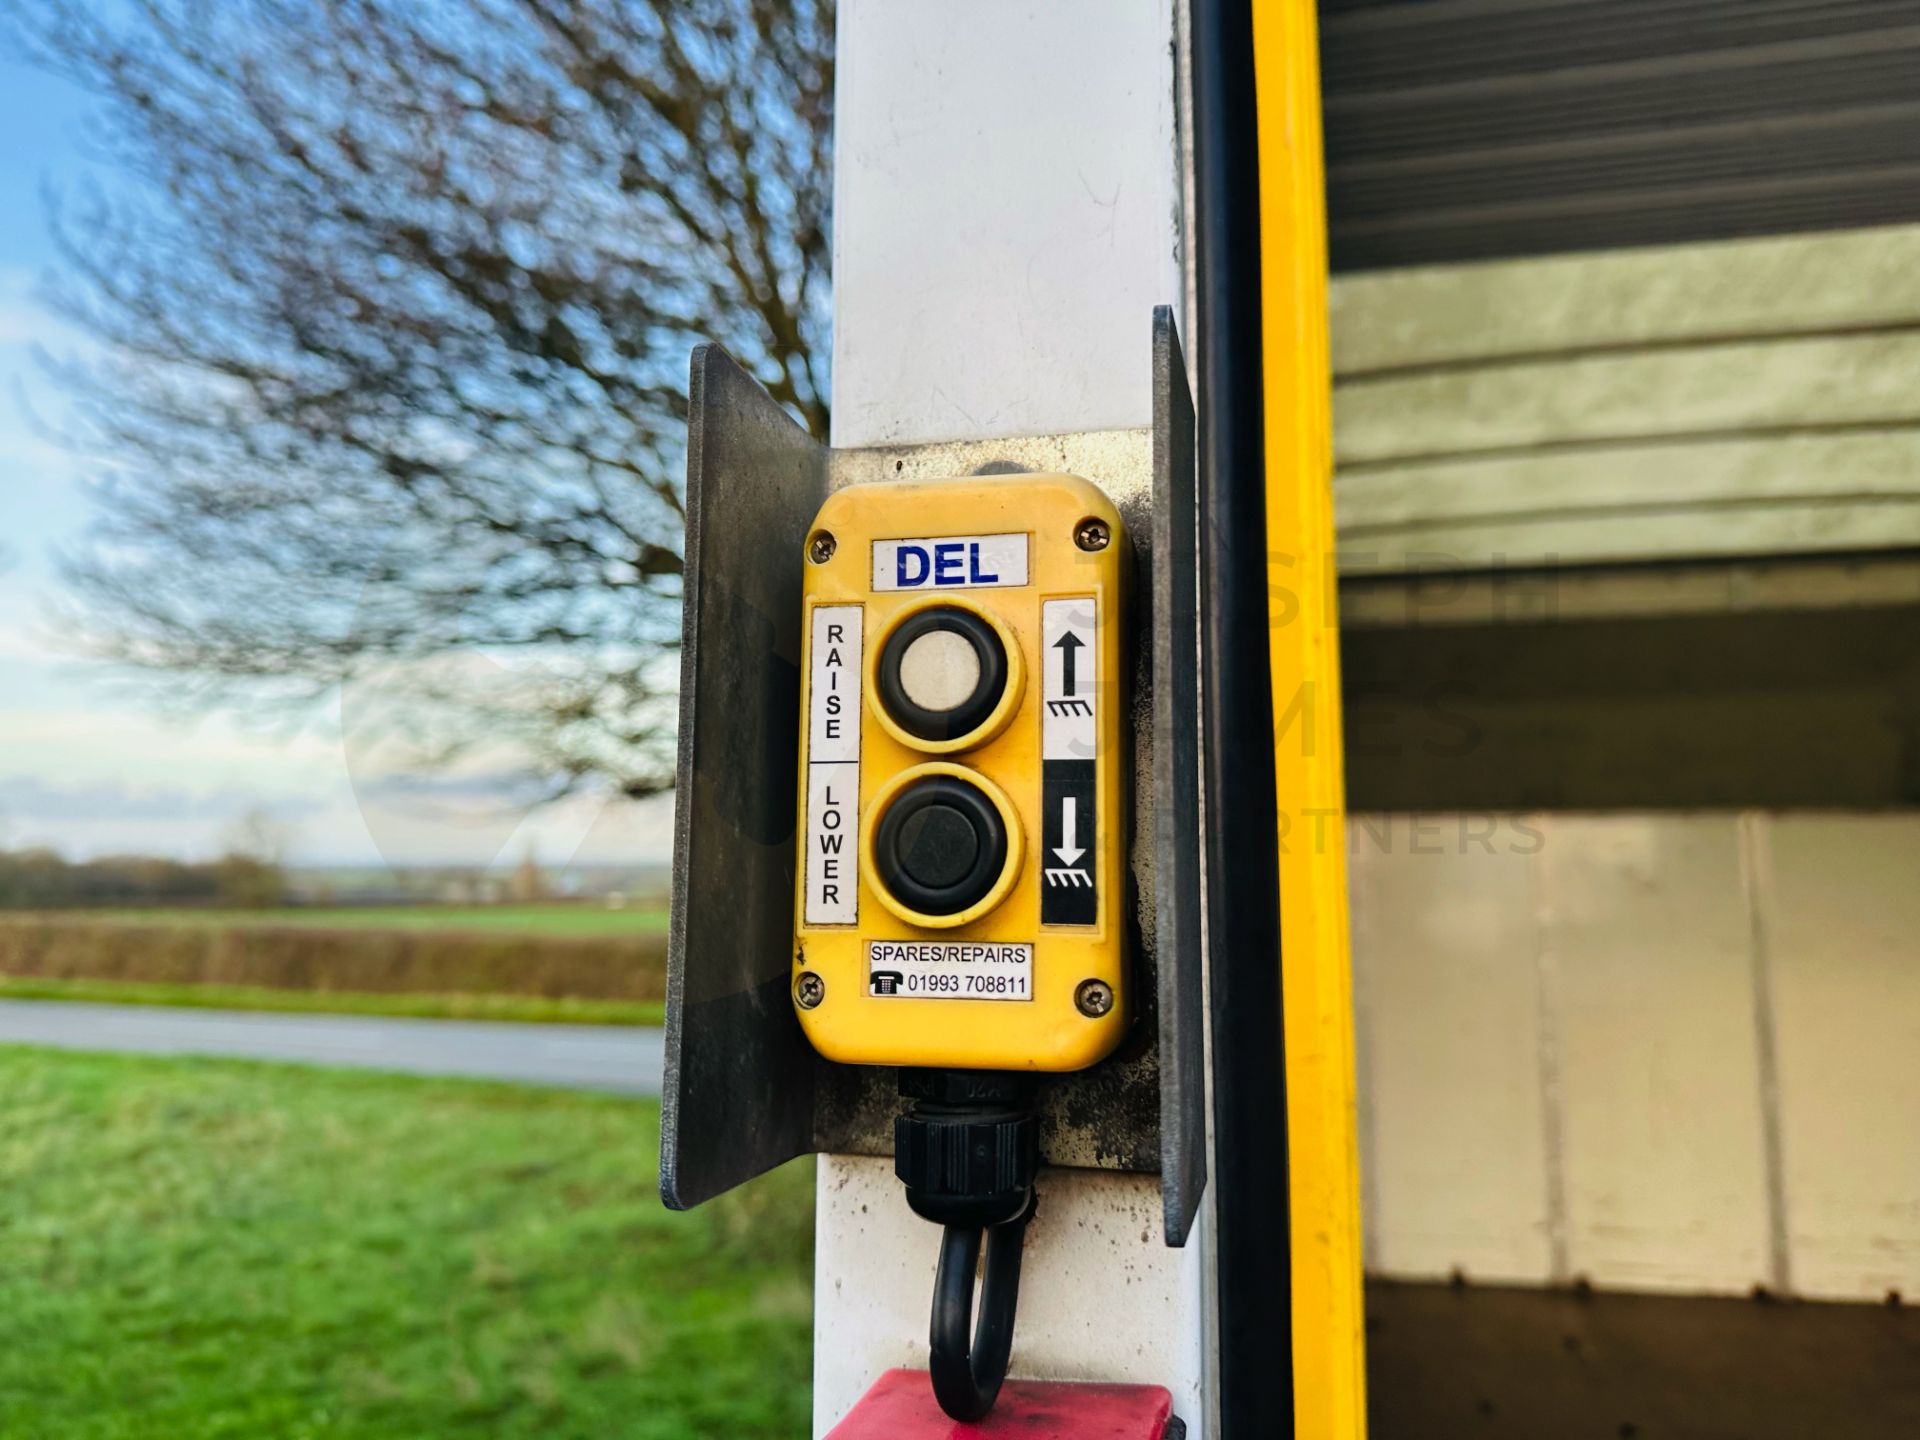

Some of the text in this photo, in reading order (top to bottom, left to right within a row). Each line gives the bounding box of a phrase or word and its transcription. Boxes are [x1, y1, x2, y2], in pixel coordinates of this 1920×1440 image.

[897, 543, 998, 587] DEL
[825, 624, 844, 739] RAISE
[820, 786, 843, 904] LOWER
[871, 946, 1026, 963] SPARES/REPAIRS
[908, 974, 1026, 993] 01993 708811
